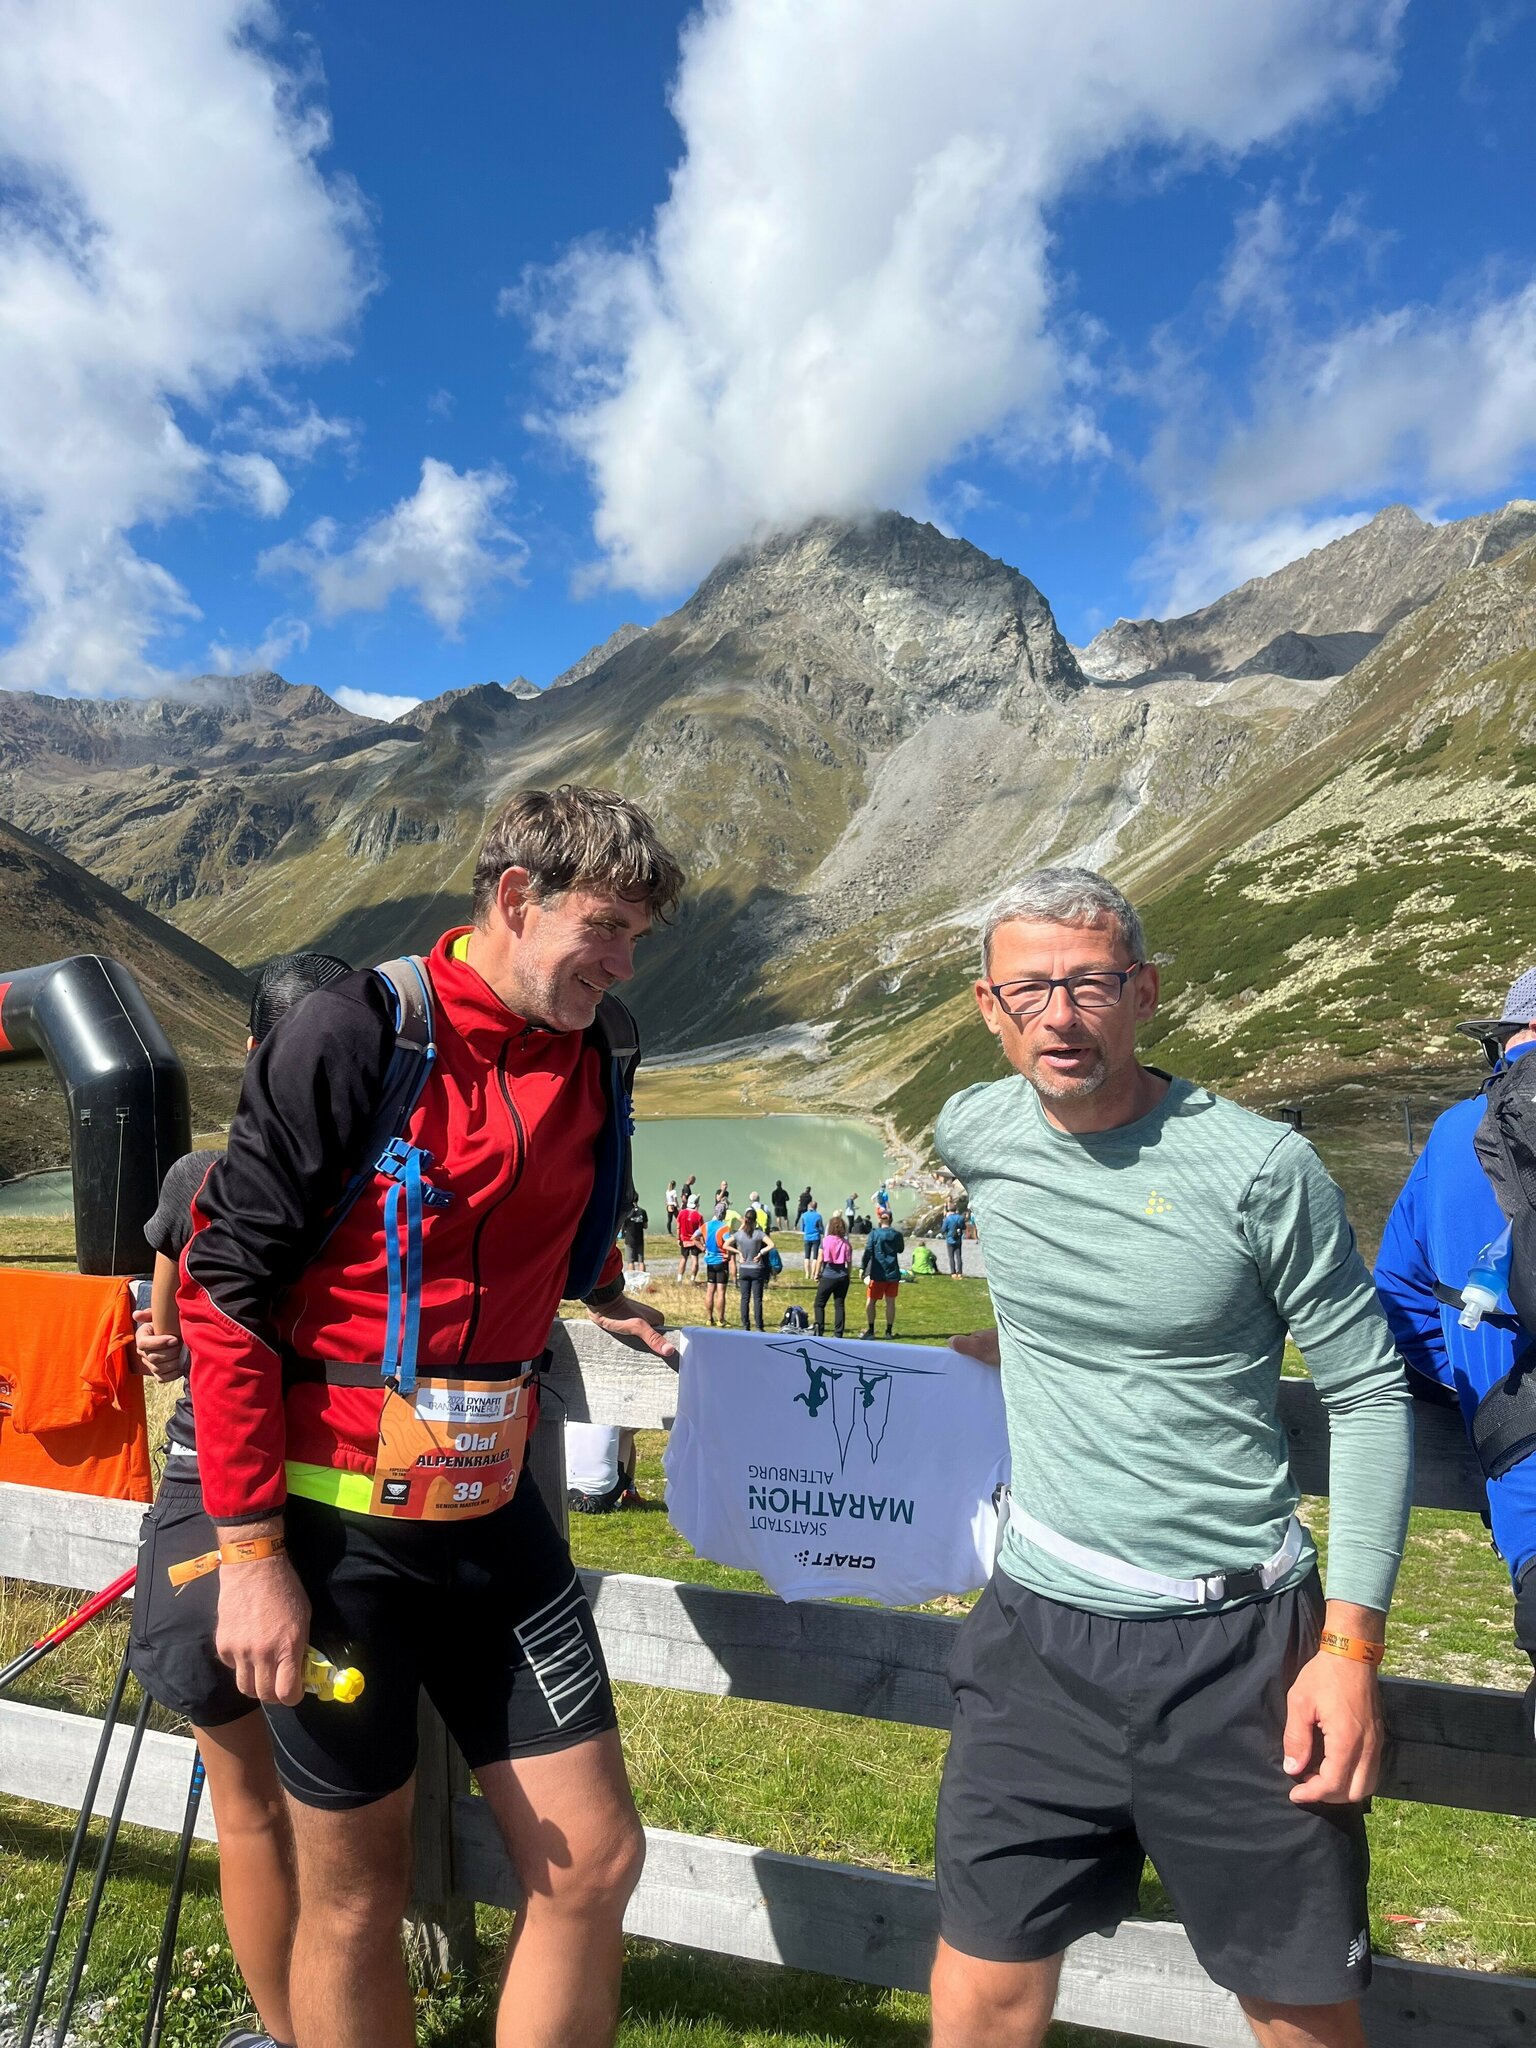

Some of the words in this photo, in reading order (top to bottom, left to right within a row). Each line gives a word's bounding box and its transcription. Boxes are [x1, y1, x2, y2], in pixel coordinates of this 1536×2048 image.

[467, 1397, 502, 1406] DYNAFIT
[455, 1432, 498, 1452] Olaf
[416, 1449, 510, 1468] ALPENKRAXLER
[749, 1465, 834, 1485] ALTENBURG
[453, 1481, 482, 1502] 39
[749, 1485, 914, 1525] MARATHON
[749, 1516, 827, 1536] SKATSTADT
[811, 1552, 876, 1569] CRAFT
